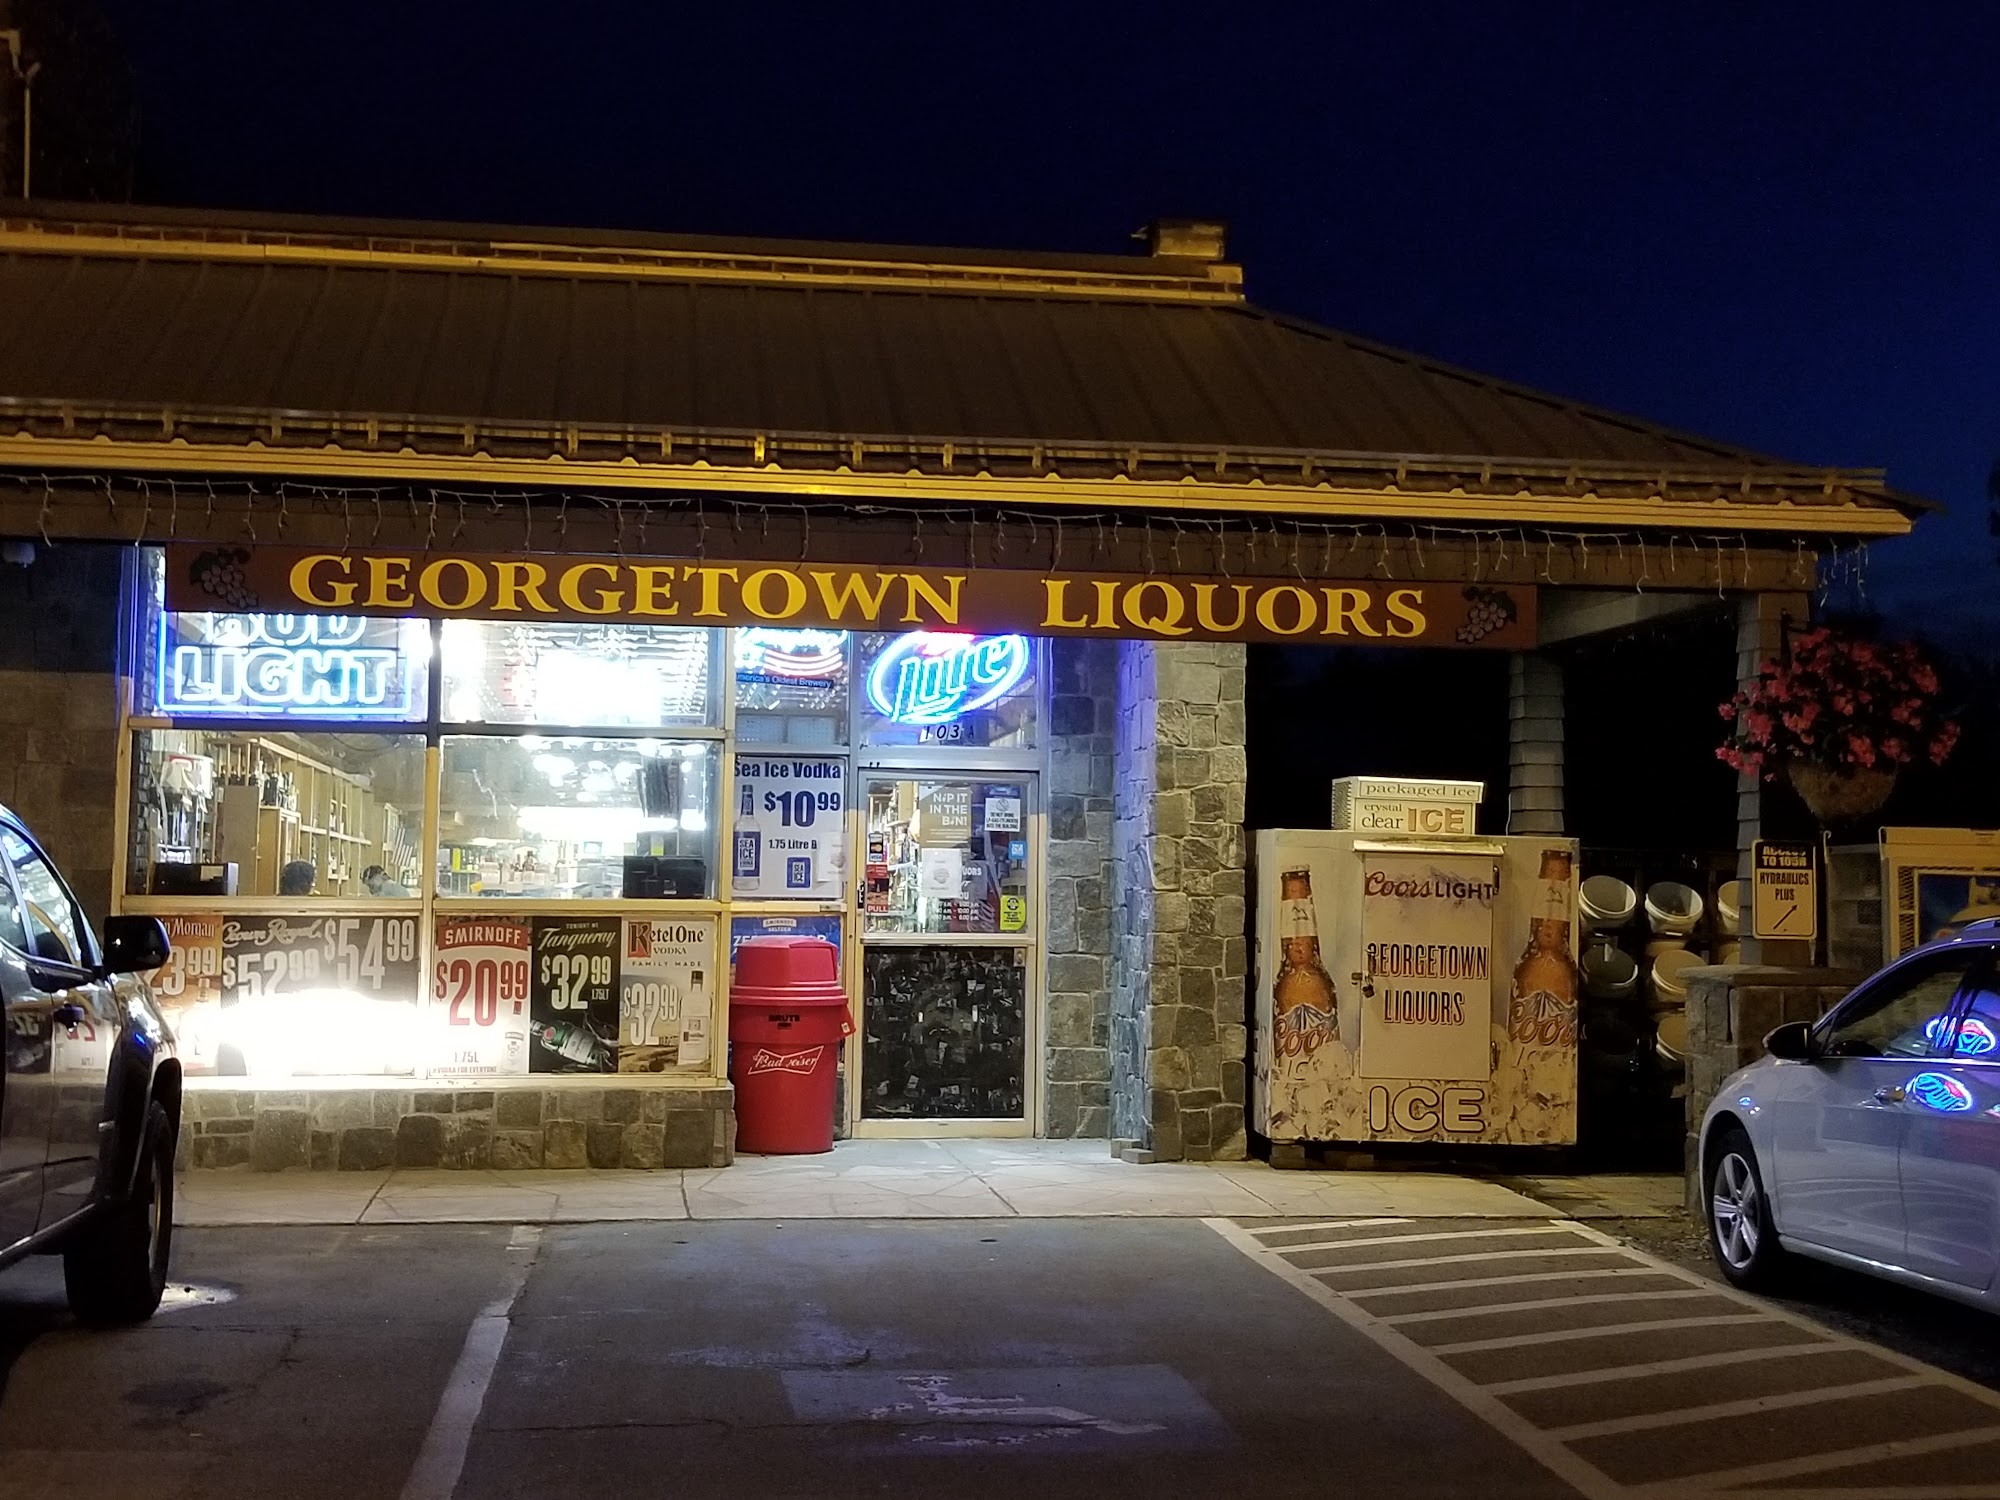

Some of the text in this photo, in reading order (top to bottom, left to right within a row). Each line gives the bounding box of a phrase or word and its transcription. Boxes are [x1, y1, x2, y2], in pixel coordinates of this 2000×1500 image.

[290, 554, 1427, 637] GEORGETOWN LIQUORS
[174, 645, 398, 704] LIGHT
[736, 674, 832, 688] merica's Oldest Brewery
[924, 725, 961, 740] 103
[735, 761, 841, 779] Sea Ice Vodka
[1366, 783, 1475, 797] packaged ice
[956, 793, 968, 803] IT
[929, 804, 968, 815] IN THE
[1364, 803, 1402, 813] crystal
[1361, 807, 1466, 833] clear ICE
[739, 839, 754, 848] SEA
[769, 838, 786, 849] 1.75
[788, 838, 808, 849] Litre
[739, 849, 754, 859] ICE
[1762, 855, 1777, 867] TO
[793, 863, 804, 872] SEA
[793, 873, 804, 882] ICE
[1760, 871, 1809, 886] HYDRAULICS
[1365, 871, 1492, 900] Coors LIGHT
[1775, 888, 1795, 901] PLUS
[172, 917, 215, 938] Morgan
[221, 918, 323, 948] Crown Royal
[445, 926, 522, 946] SMIRNOFF
[537, 927, 616, 952] Tanqueray
[628, 922, 705, 957] Ketel One
[653, 946, 687, 955] VODKA
[1384, 989, 1465, 1025] LIQUORS
[768, 1014, 801, 1022] BRUTE
[753, 1055, 818, 1069] Budeiser
[1369, 1085, 1486, 1134] ICE
